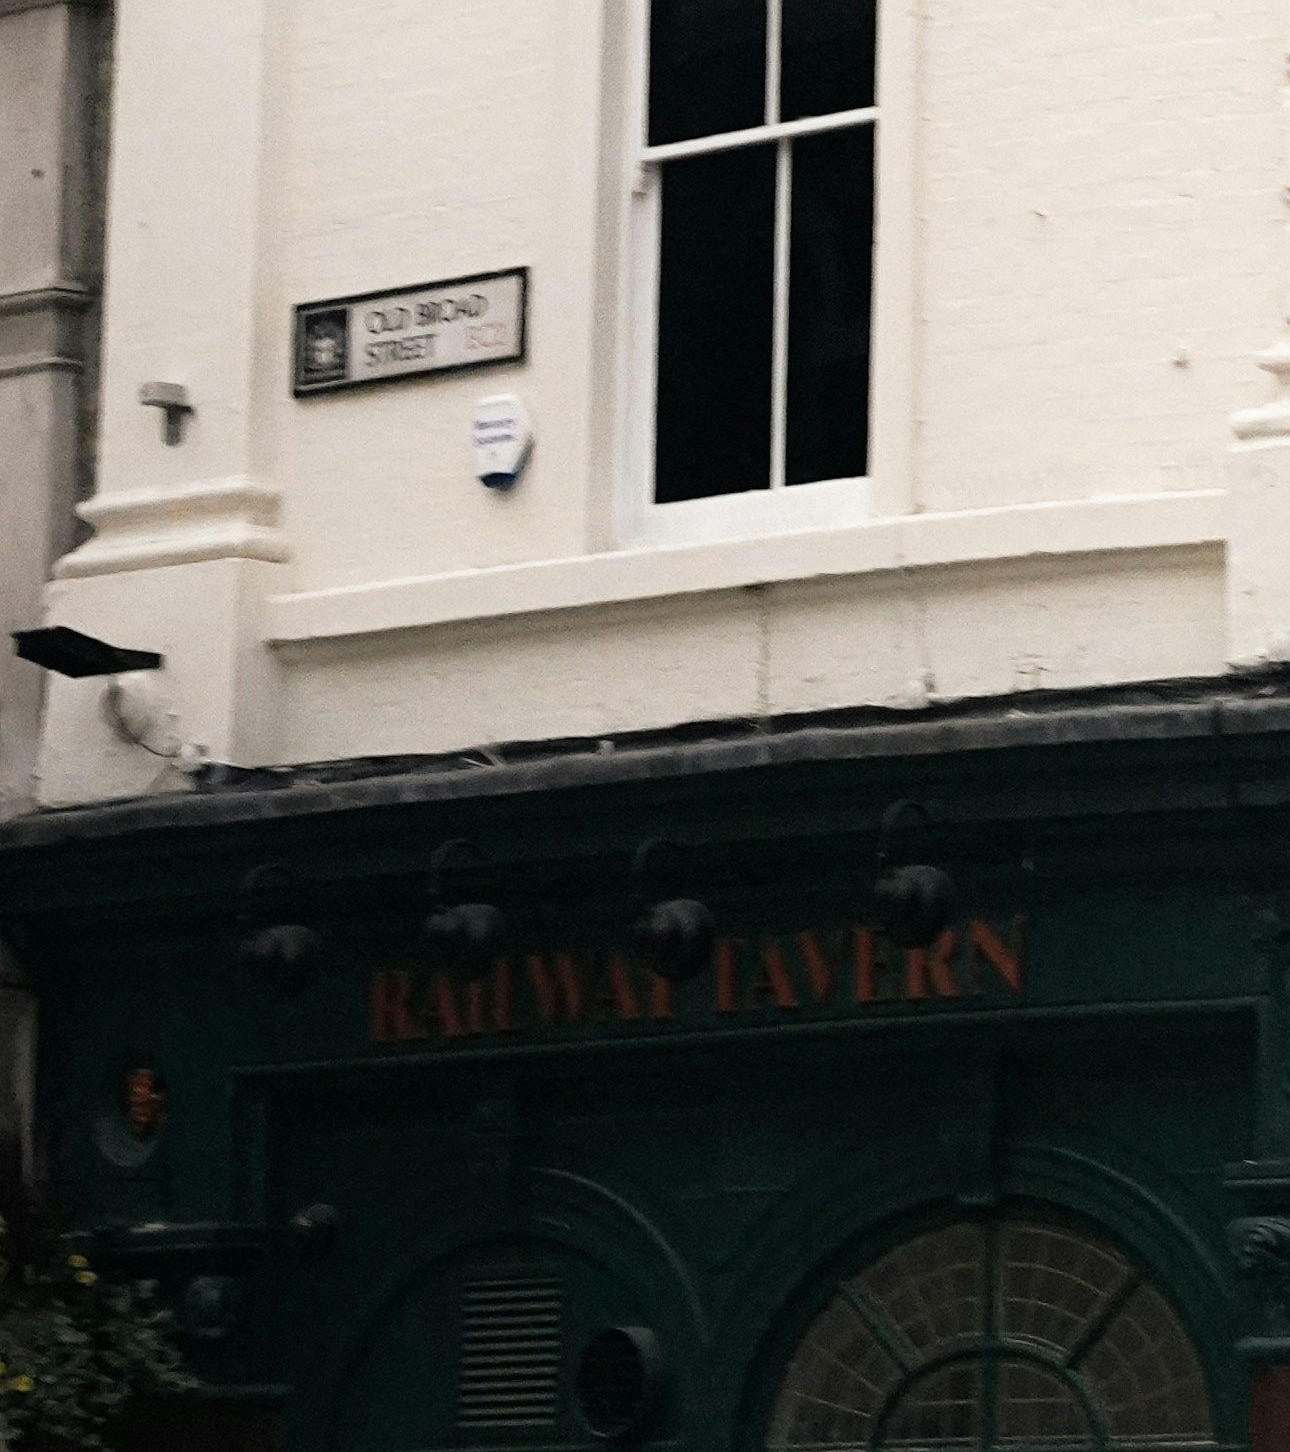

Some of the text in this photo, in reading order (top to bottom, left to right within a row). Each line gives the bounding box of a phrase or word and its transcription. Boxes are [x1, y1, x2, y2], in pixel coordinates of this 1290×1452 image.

[365, 294, 490, 334] OLD BROAD
[366, 333, 438, 366] STREET
[712, 913, 1027, 1014] TAVERN
